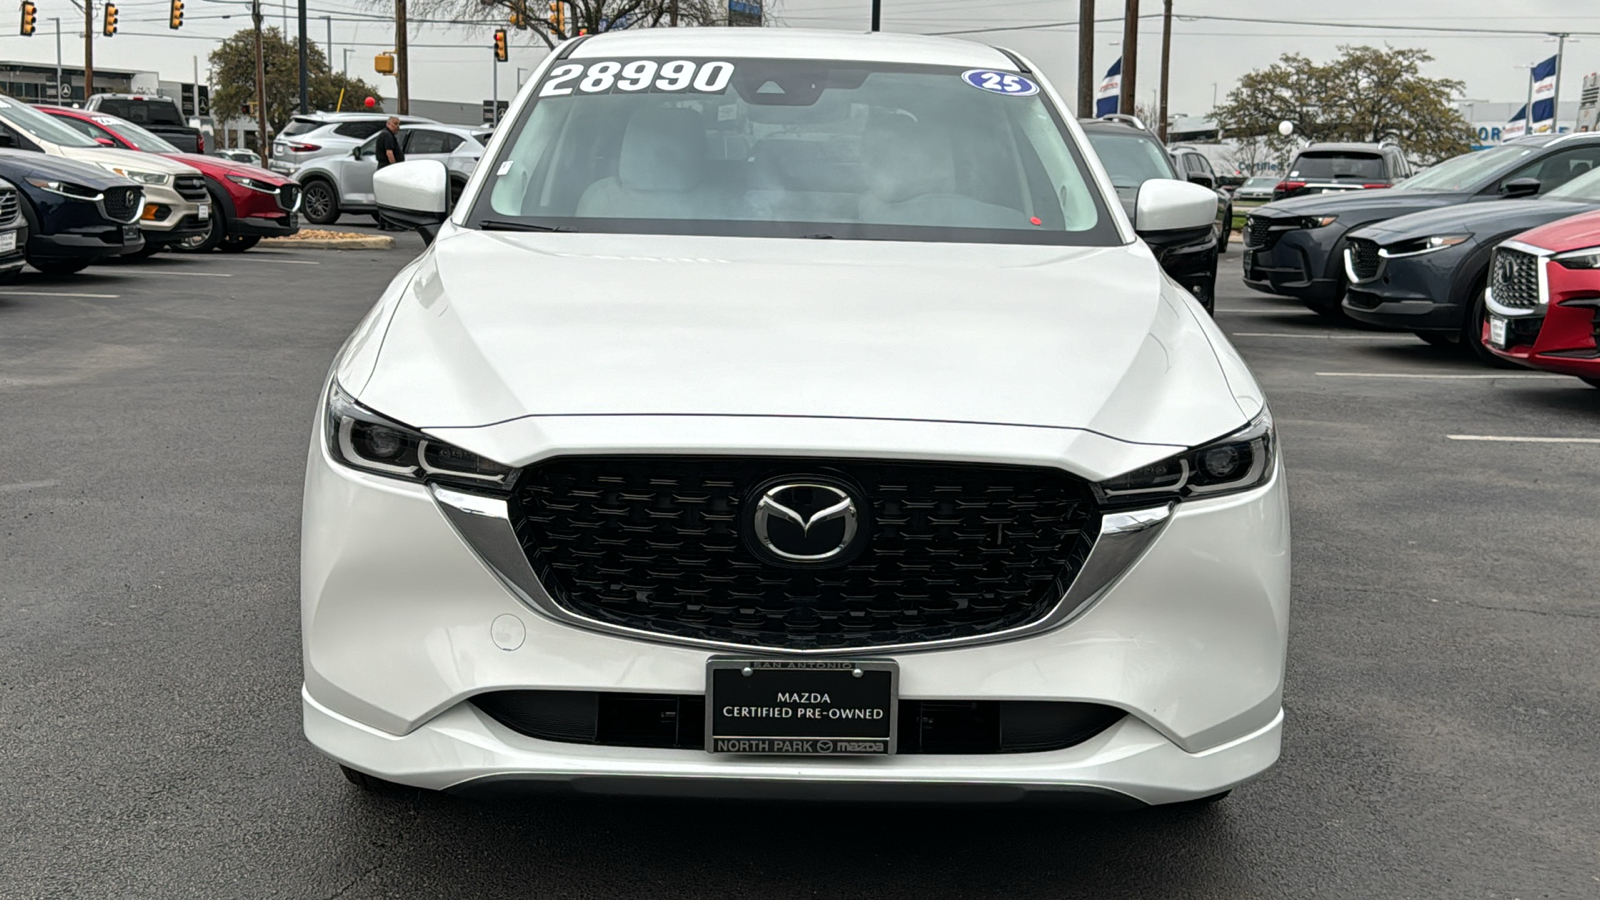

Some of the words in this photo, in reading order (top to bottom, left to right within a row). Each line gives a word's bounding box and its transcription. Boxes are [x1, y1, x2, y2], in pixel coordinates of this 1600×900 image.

[538, 60, 735, 98] 28990
[980, 72, 1022, 92] 25
[753, 661, 782, 669] SAN
[786, 661, 853, 670] ANTONIO
[776, 692, 831, 703] MAZDA
[723, 706, 792, 718] CERTIFIED
[797, 708, 883, 719] PRE-OWNED
[717, 740, 769, 752] NORTH
[773, 741, 813, 752] PARK
[836, 741, 885, 752] mazda
